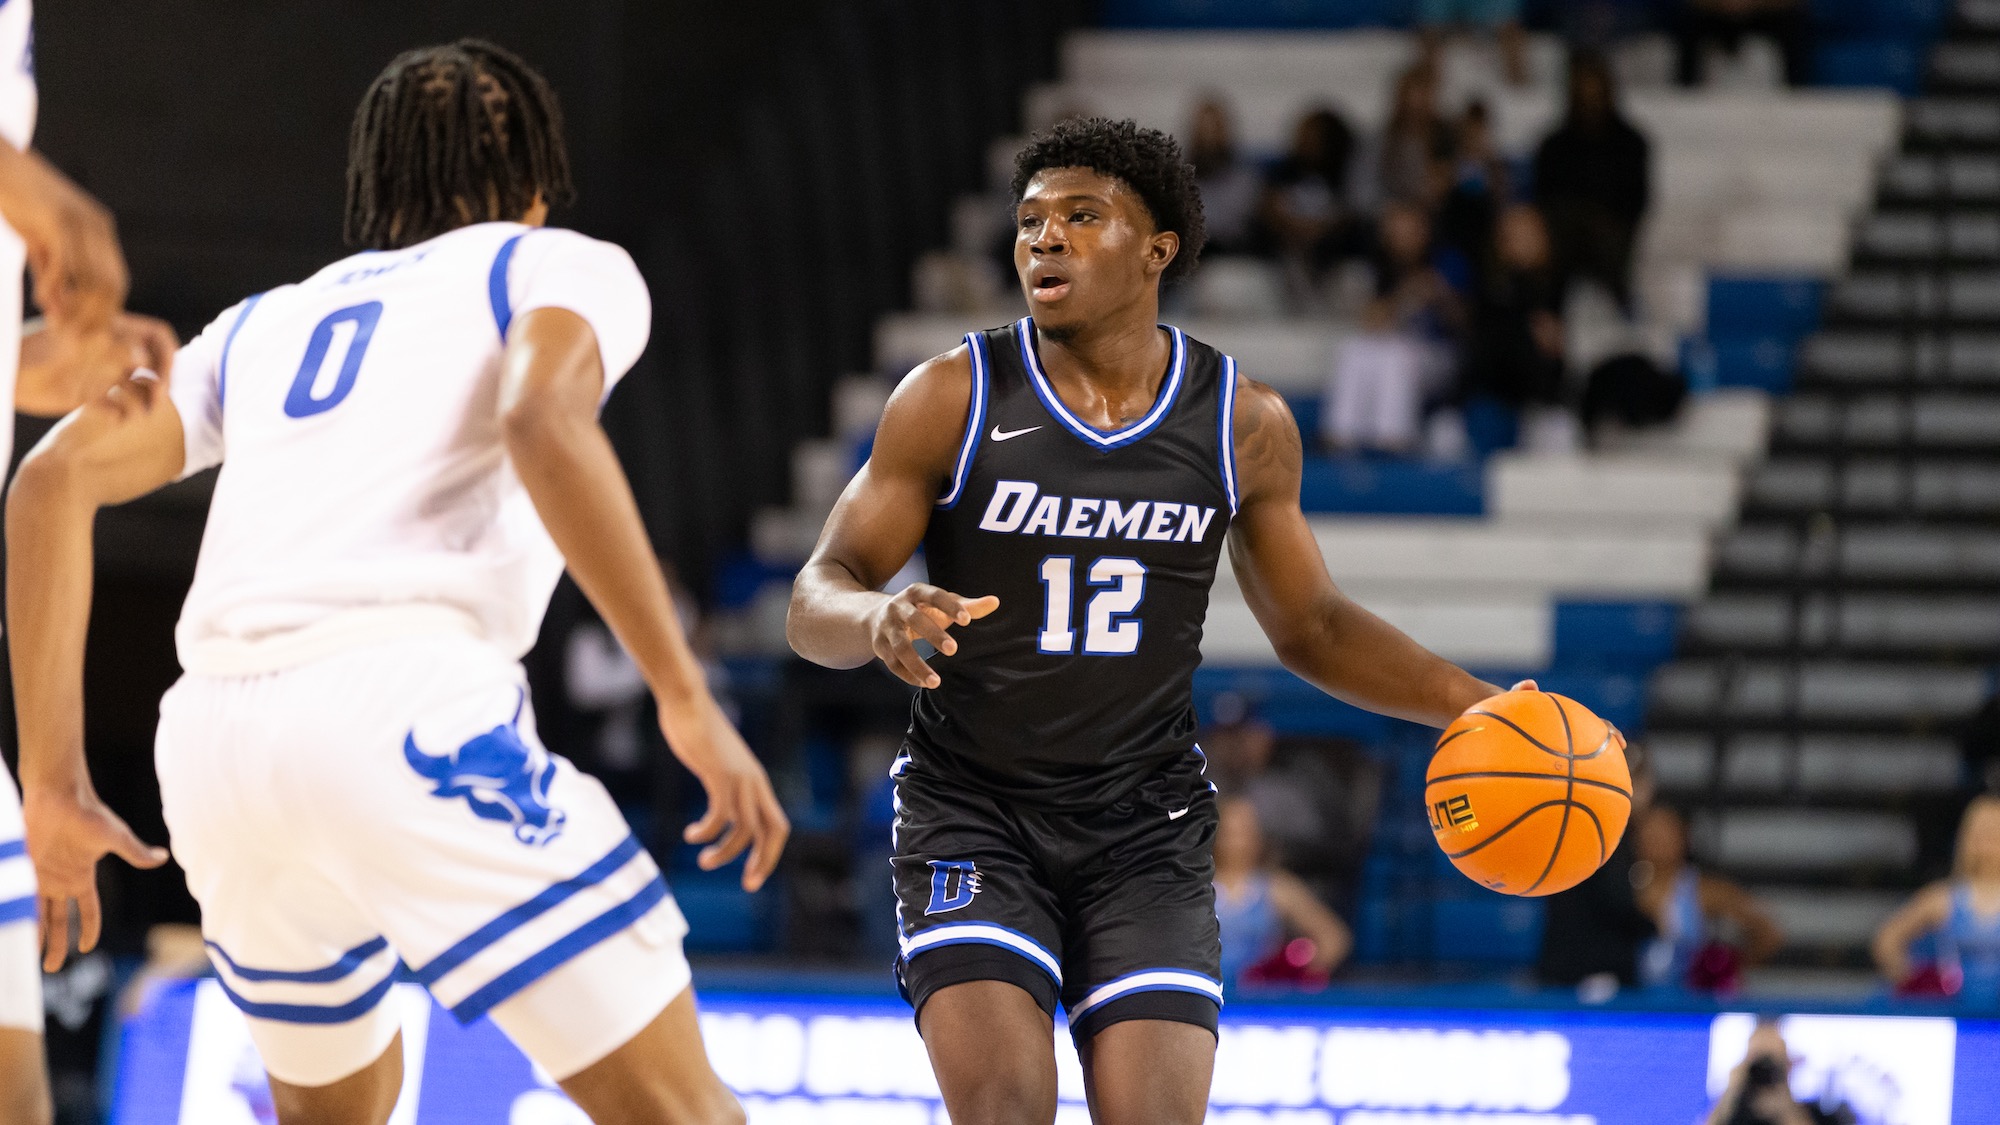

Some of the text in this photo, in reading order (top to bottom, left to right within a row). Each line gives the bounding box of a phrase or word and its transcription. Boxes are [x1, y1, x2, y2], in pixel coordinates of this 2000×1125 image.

[284, 301, 383, 418] 0
[979, 480, 1217, 542] DAEMEN
[1036, 554, 1149, 656] 12
[924, 860, 984, 916] D
